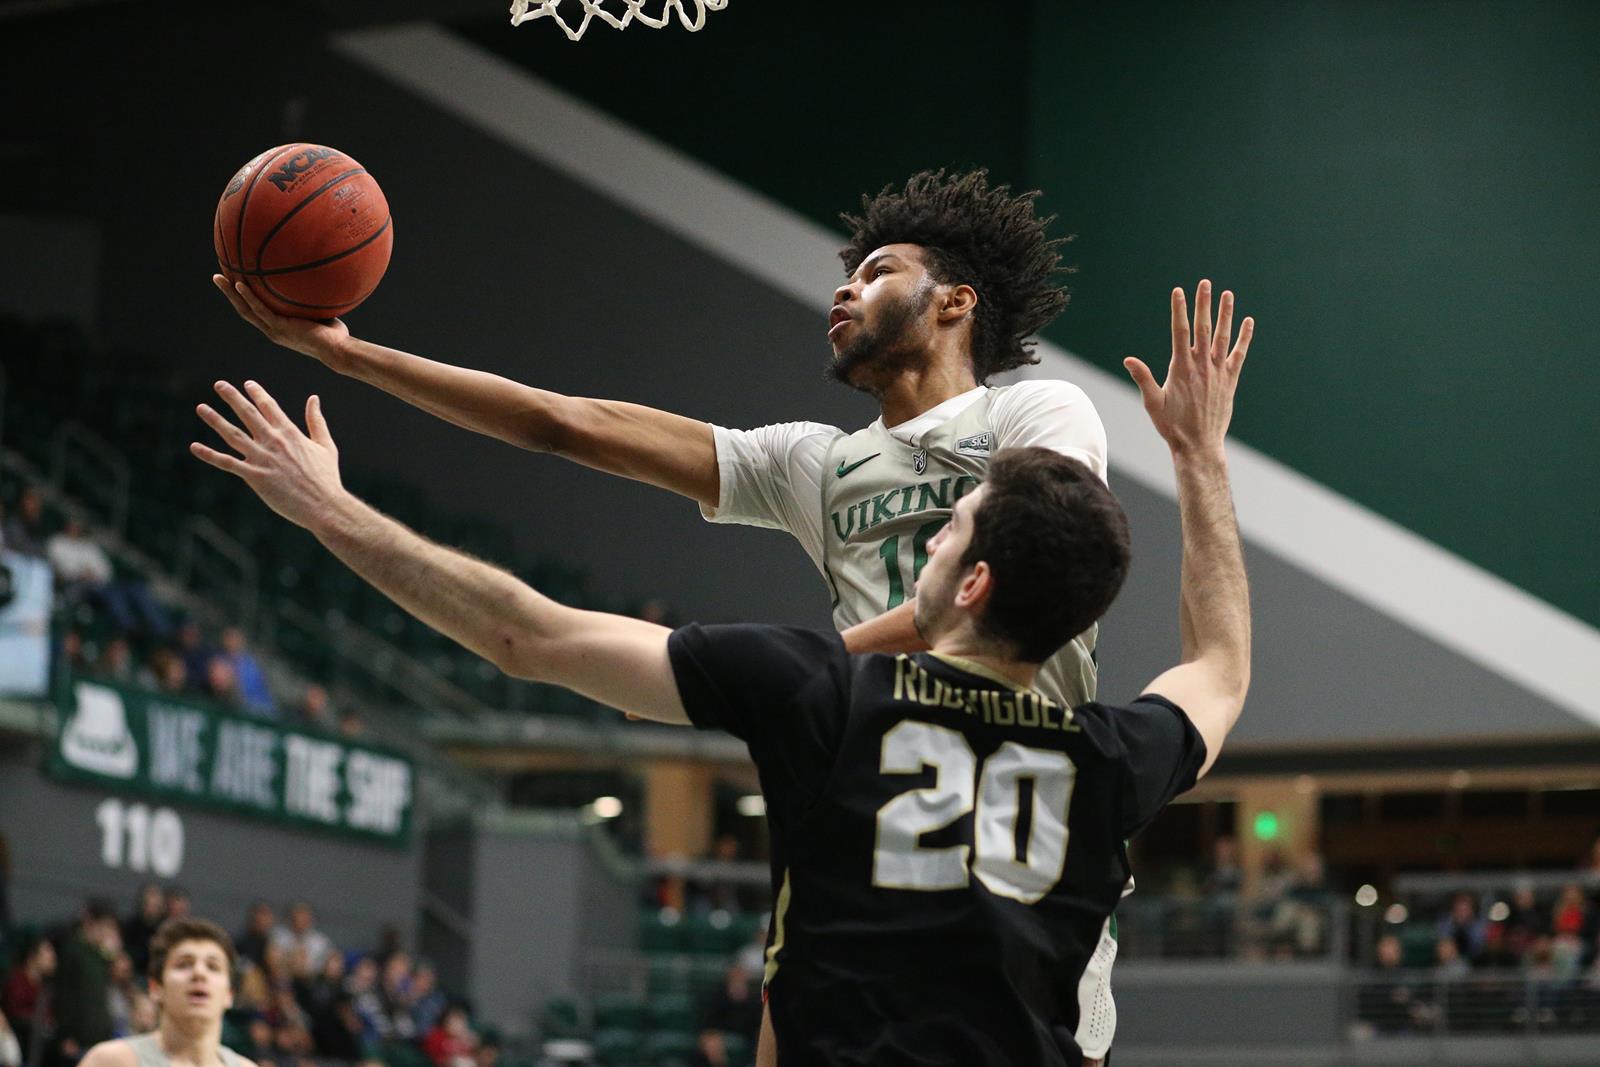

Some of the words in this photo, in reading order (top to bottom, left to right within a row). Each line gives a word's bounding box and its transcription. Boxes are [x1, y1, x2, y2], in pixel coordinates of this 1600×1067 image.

[146, 702, 206, 794] WE
[209, 718, 277, 811] ARE
[284, 731, 343, 825] THE
[872, 718, 1077, 905] 20
[96, 798, 185, 878] 110
